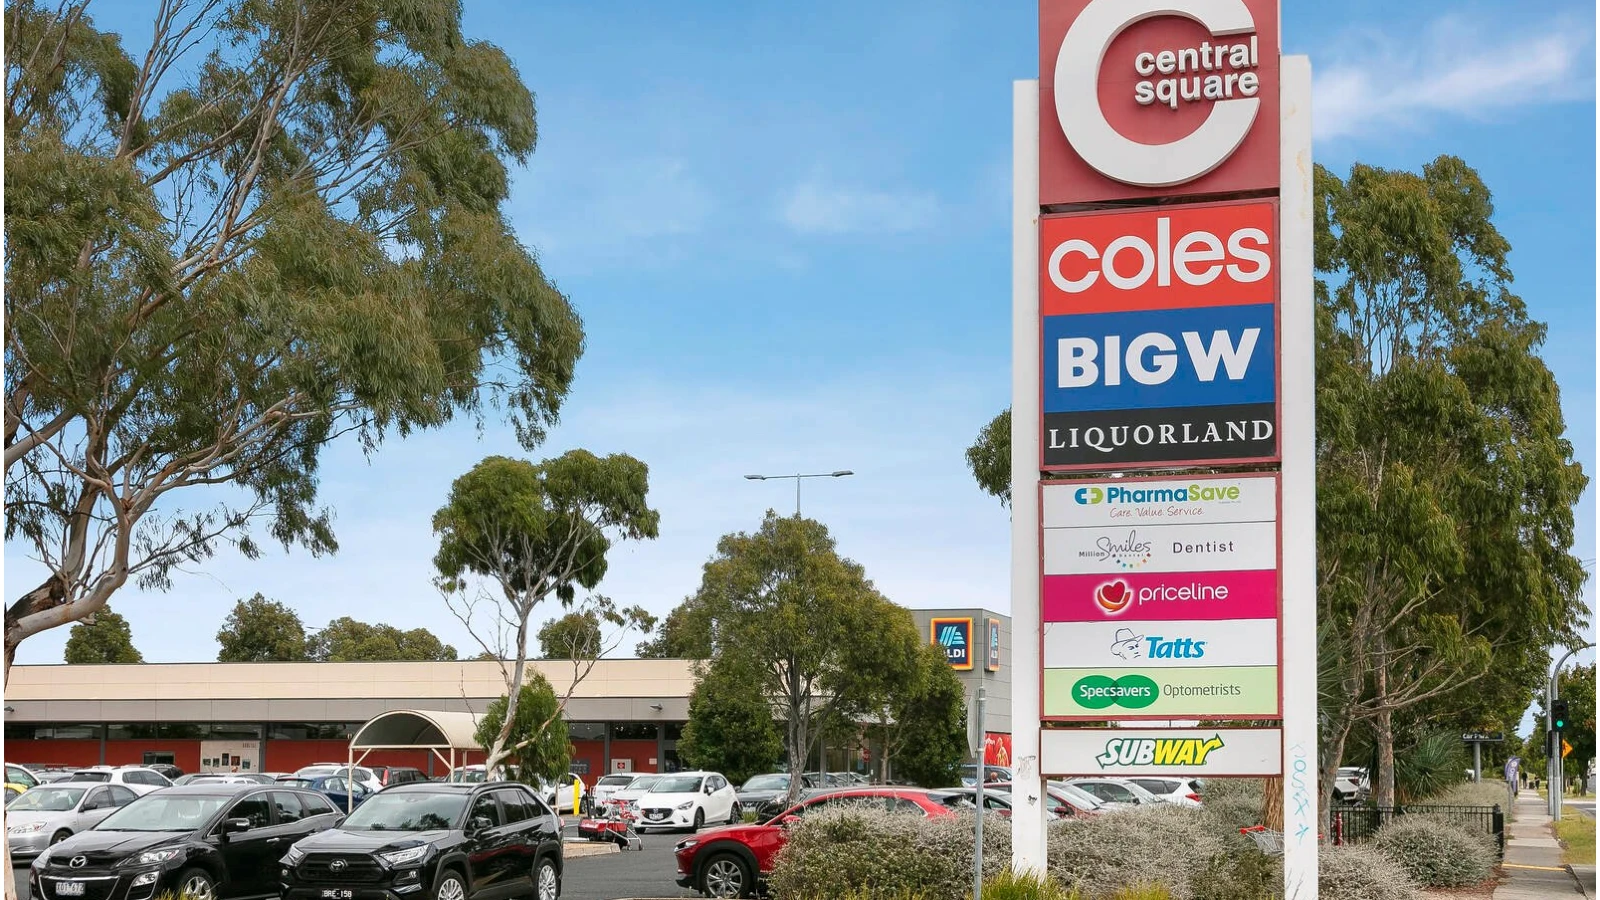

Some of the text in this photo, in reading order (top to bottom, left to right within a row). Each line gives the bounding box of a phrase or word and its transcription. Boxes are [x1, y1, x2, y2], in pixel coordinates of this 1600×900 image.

[1134, 36, 1258, 77] central
[1134, 70, 1260, 109] square
[1048, 217, 1270, 293] coles
[1049, 419, 1273, 452] LIQUORLAND
[1107, 484, 1240, 504] PharmaSave
[1096, 530, 1151, 561] Smiles
[1173, 541, 1234, 553] Dentist
[1139, 583, 1228, 605] priceline
[945, 649, 965, 658] LDI
[1146, 637, 1207, 658] Tatts
[1080, 684, 1241, 700] Specsavers Optometrists
[1098, 736, 1219, 767] SUBWAY
